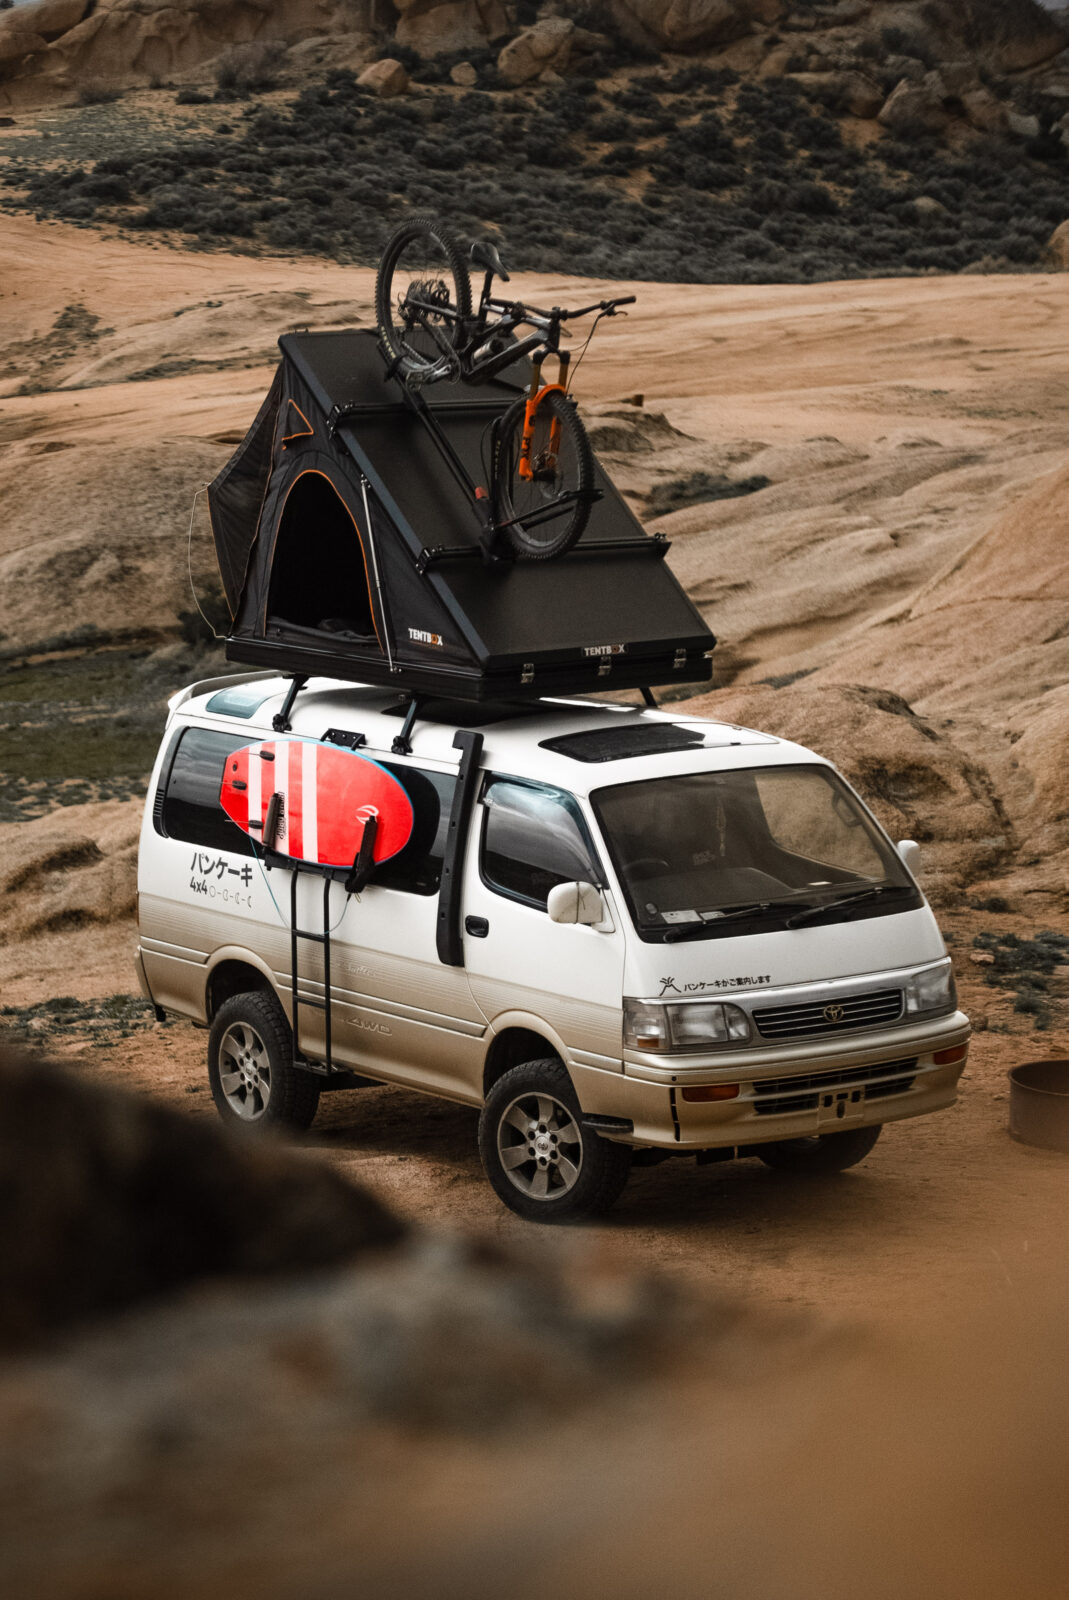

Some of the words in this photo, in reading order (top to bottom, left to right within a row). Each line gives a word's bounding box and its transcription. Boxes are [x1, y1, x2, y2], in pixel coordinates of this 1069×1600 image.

[408, 627, 444, 647] TENTBOX
[584, 643, 625, 657] TENTBOX
[190, 852, 253, 888] パンケーキ
[190, 876, 208, 895] 4x4
